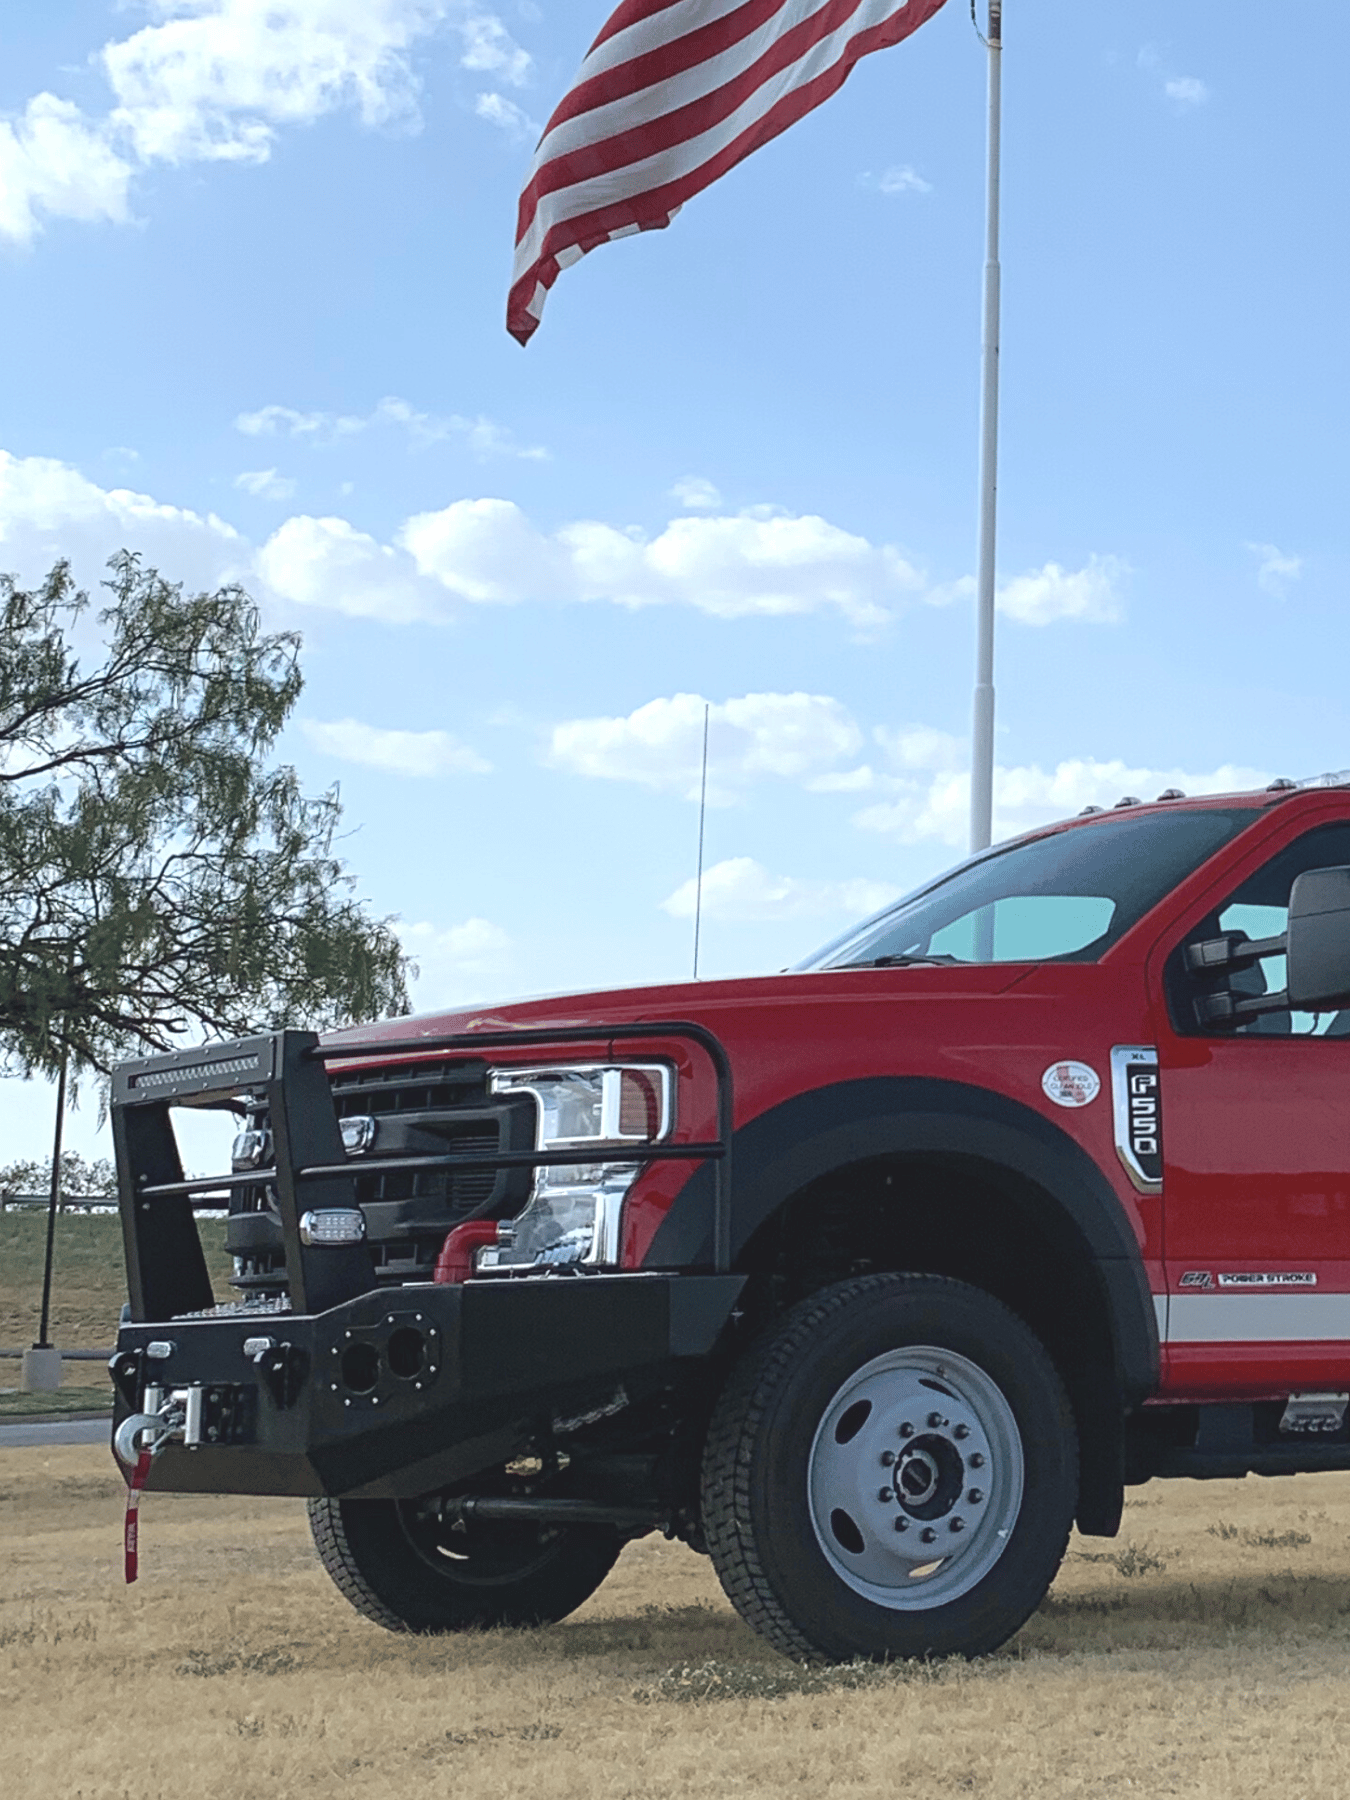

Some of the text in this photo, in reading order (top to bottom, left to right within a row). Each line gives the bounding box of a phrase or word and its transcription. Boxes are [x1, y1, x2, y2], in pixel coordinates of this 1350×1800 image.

[1131, 1052, 1146, 1060] XL
[1222, 1273, 1264, 1283] POWER
[1266, 1273, 1313, 1283] STROKE
